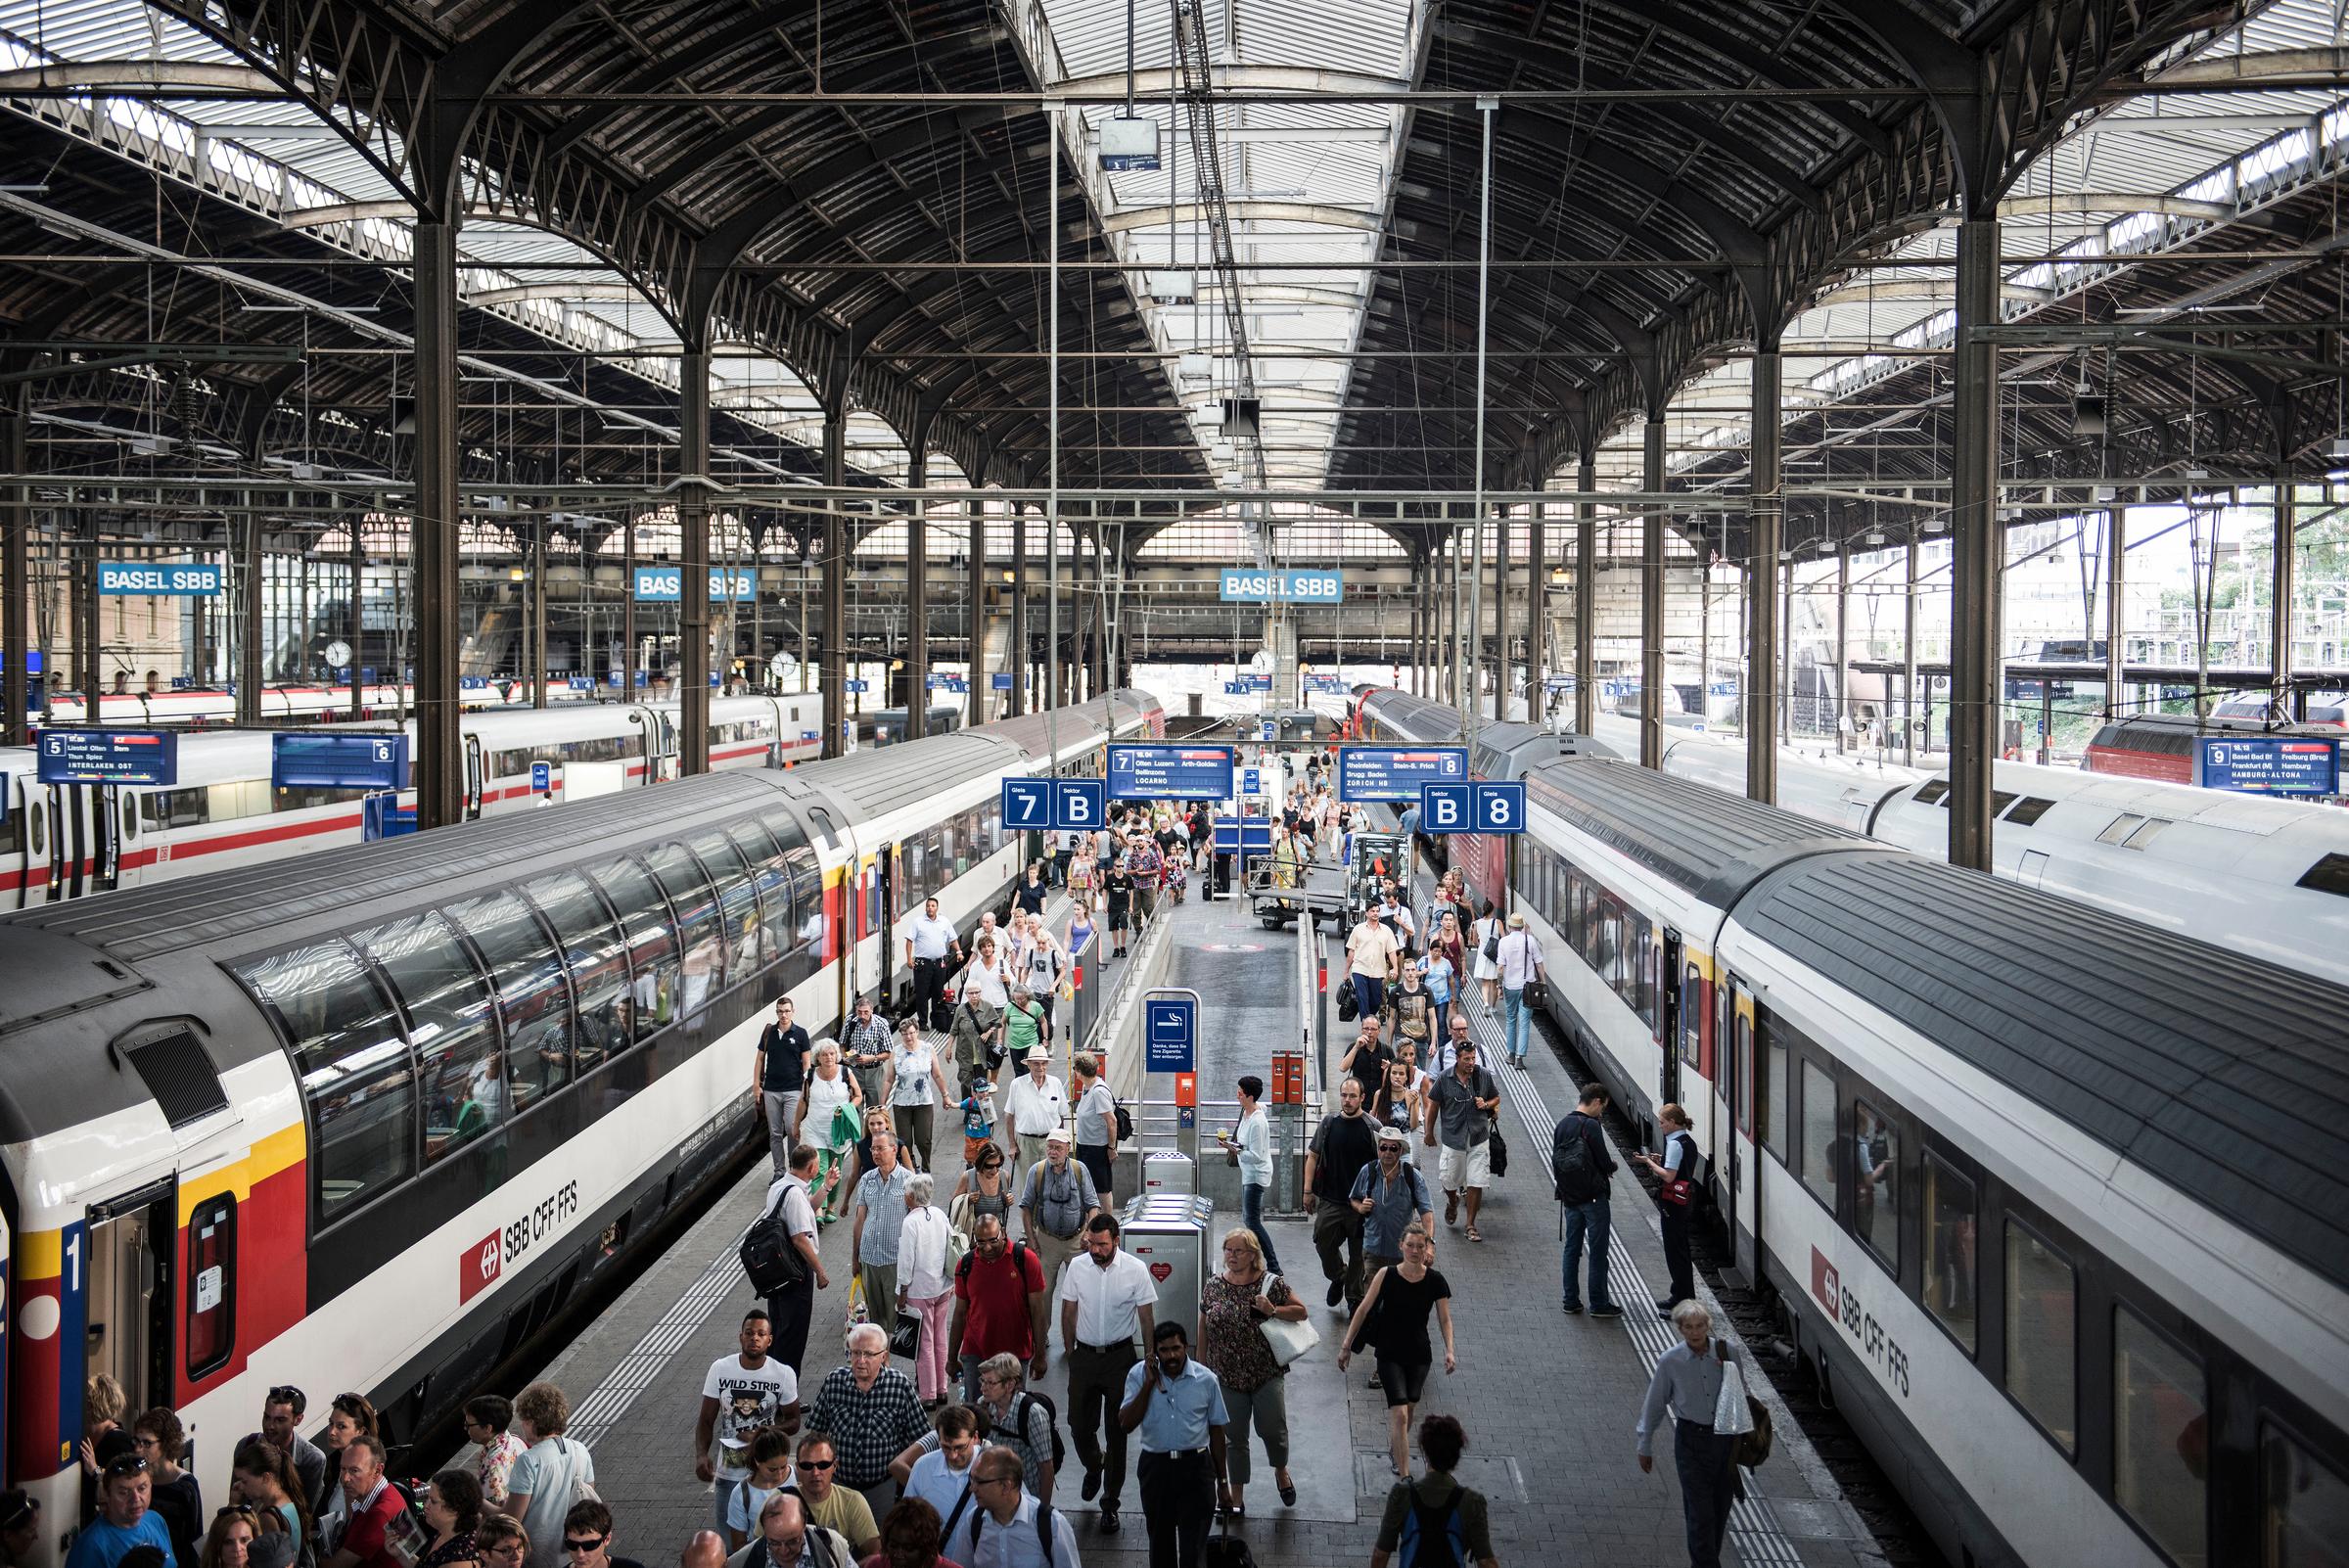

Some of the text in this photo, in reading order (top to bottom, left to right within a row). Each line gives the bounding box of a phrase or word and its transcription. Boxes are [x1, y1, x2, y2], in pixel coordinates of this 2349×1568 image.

[104, 572, 215, 589] BASEL SBB
[639, 576, 751, 595] BAS SBB
[1225, 576, 1337, 596] BASEL SBB
[51, 742, 61, 754] 5
[379, 747, 389, 760] 6
[2214, 751, 2224, 763] 9
[1119, 758, 1128, 769] 7
[1447, 761, 1456, 773] 8
[1018, 795, 1036, 820] 7
[1069, 796, 1089, 821] B
[1437, 799, 1457, 824] B
[1490, 798, 1509, 824] 8
[505, 1179, 577, 1264] SBB CFF FFS
[67, 1233, 80, 1292] 1
[1842, 1285, 1910, 1399] SBB CFF FFS
[719, 1378, 781, 1392] WILD STRIP
